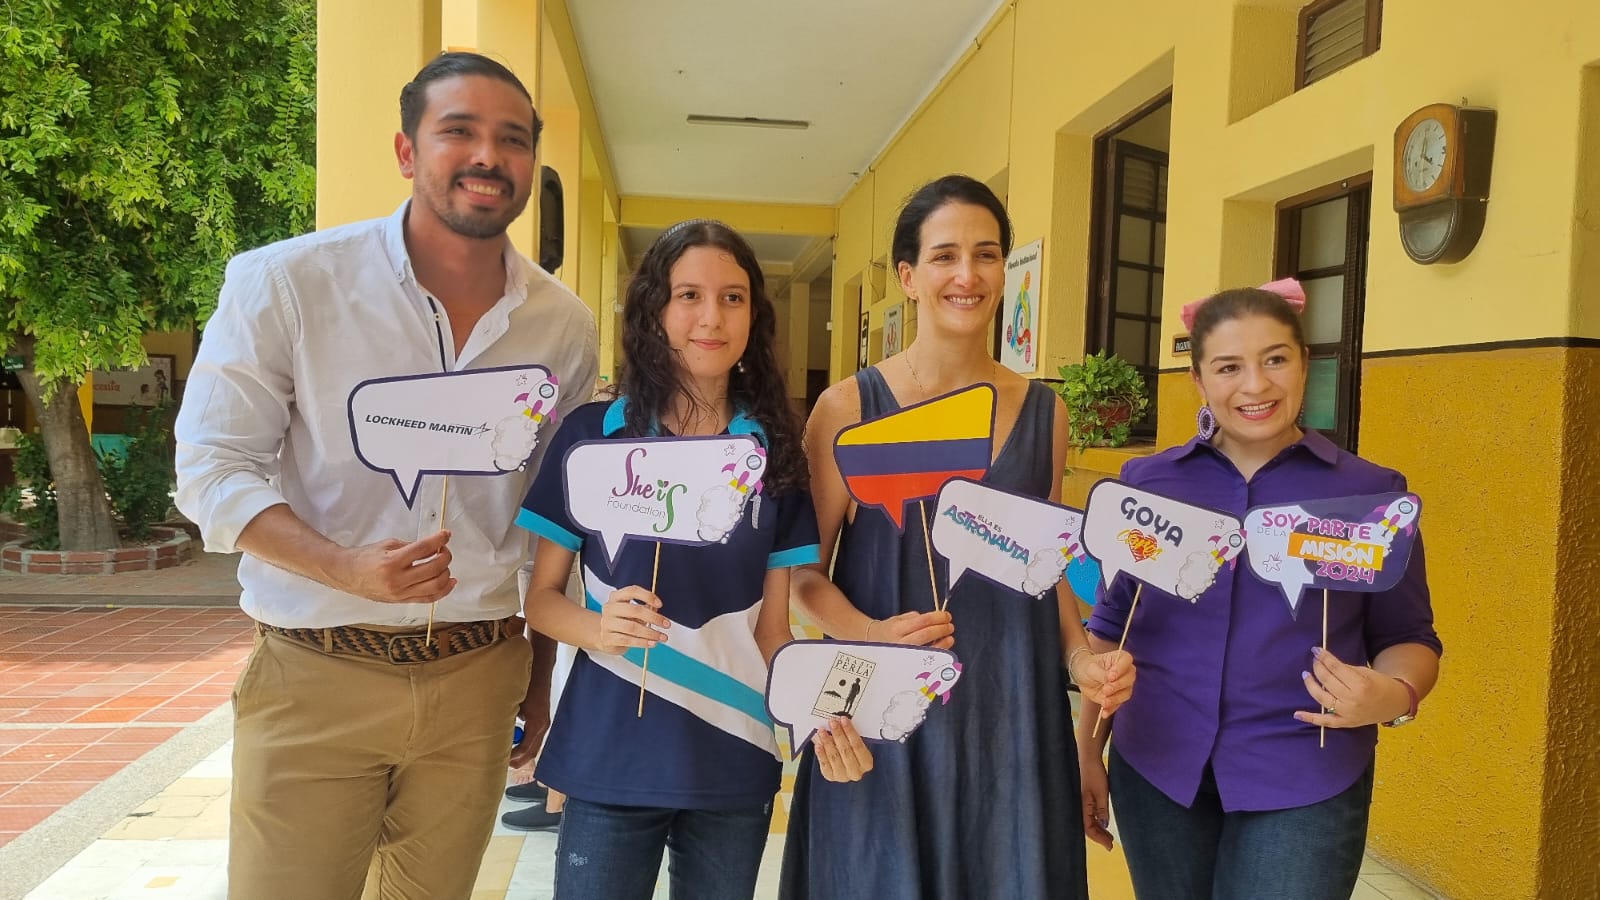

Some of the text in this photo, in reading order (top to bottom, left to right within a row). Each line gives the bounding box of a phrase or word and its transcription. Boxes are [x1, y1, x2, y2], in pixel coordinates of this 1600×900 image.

[365, 414, 473, 436] LOCKHEED MARTIN
[611, 447, 656, 499] She
[607, 496, 667, 519] Foundation
[943, 504, 1030, 565] ASTRONAUTA
[977, 513, 1003, 533] ELLA ES
[1120, 496, 1184, 548] GOYA
[1256, 525, 1287, 538] DE LA
[1262, 510, 1372, 541] SOY PARTE
[1299, 540, 1375, 566] MISIÓN
[1315, 559, 1376, 585] 2024
[834, 659, 870, 677] PERLA
